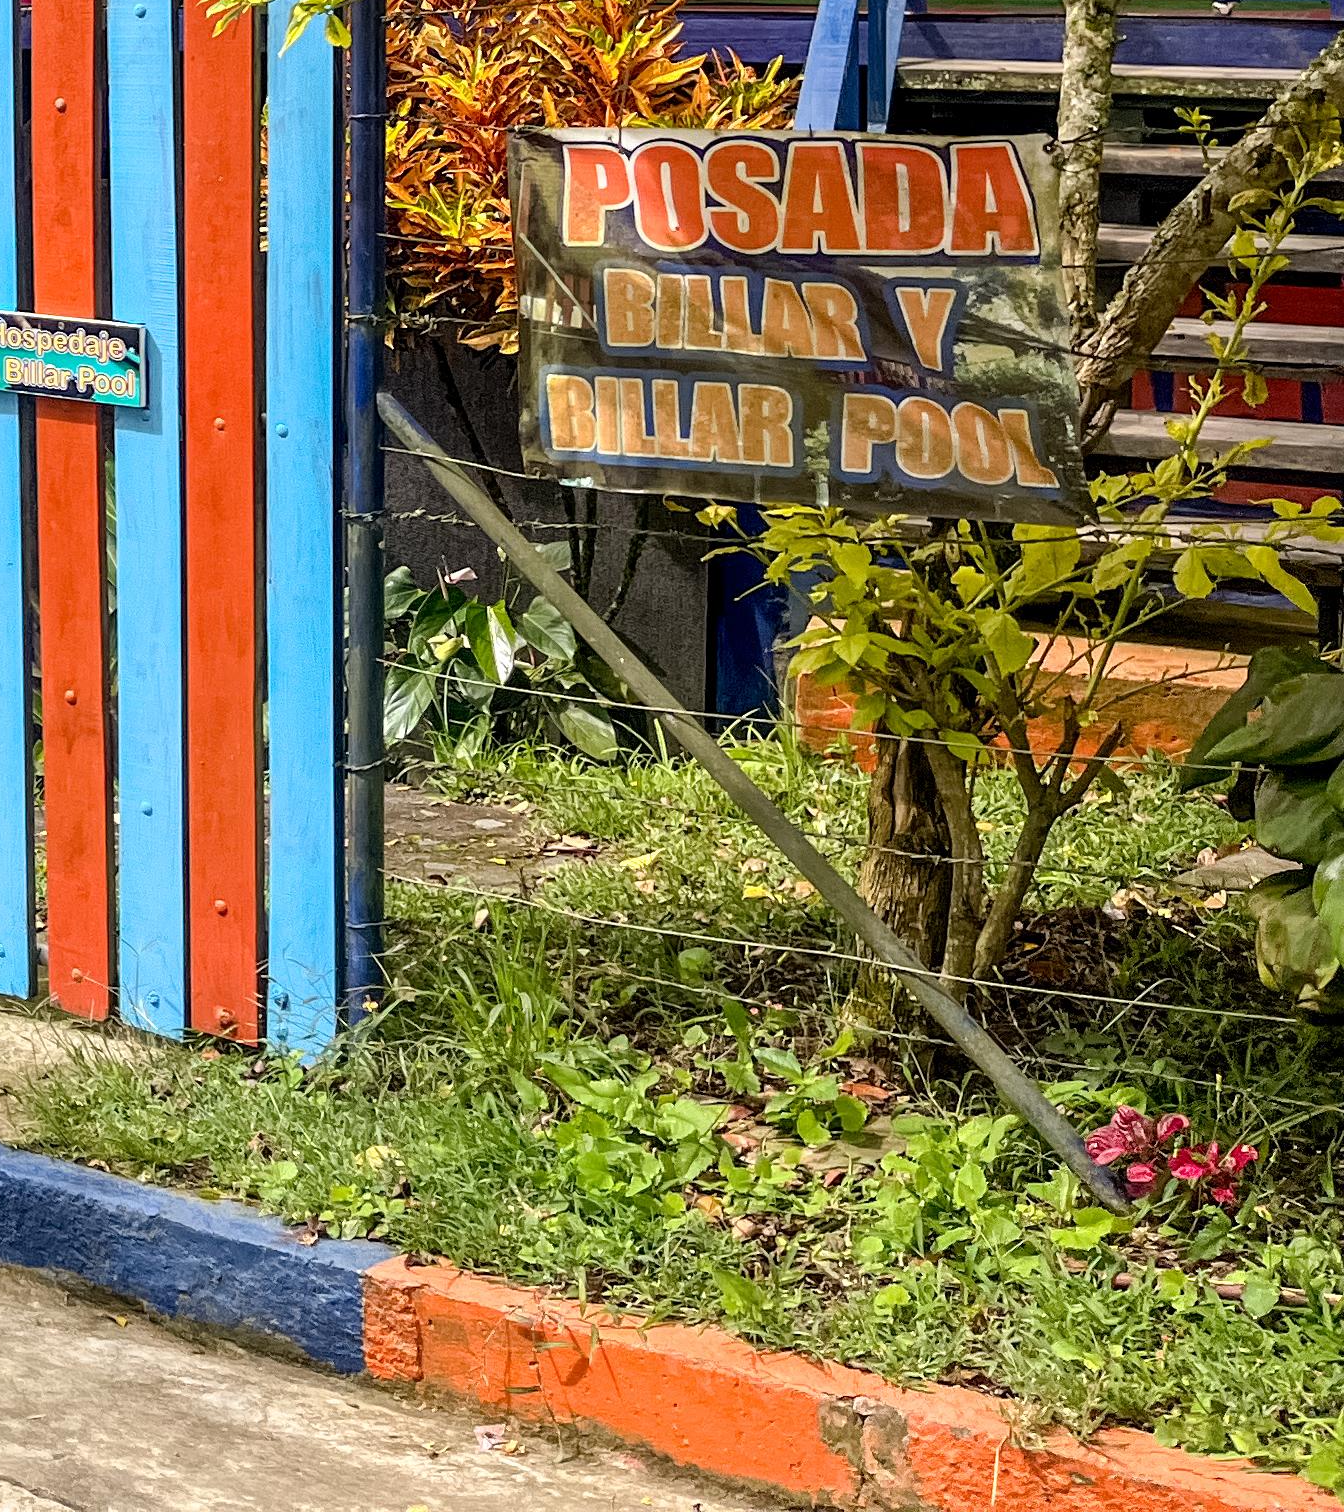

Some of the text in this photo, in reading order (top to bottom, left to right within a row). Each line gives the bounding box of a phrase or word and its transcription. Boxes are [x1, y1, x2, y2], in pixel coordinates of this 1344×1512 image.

[561, 140, 1041, 258] POSADA
[603, 266, 954, 371] BILLAR Y
[4, 357, 72, 390] Billar
[76, 364, 136, 398] Pool
[545, 373, 1061, 488] BILLAR POOL
